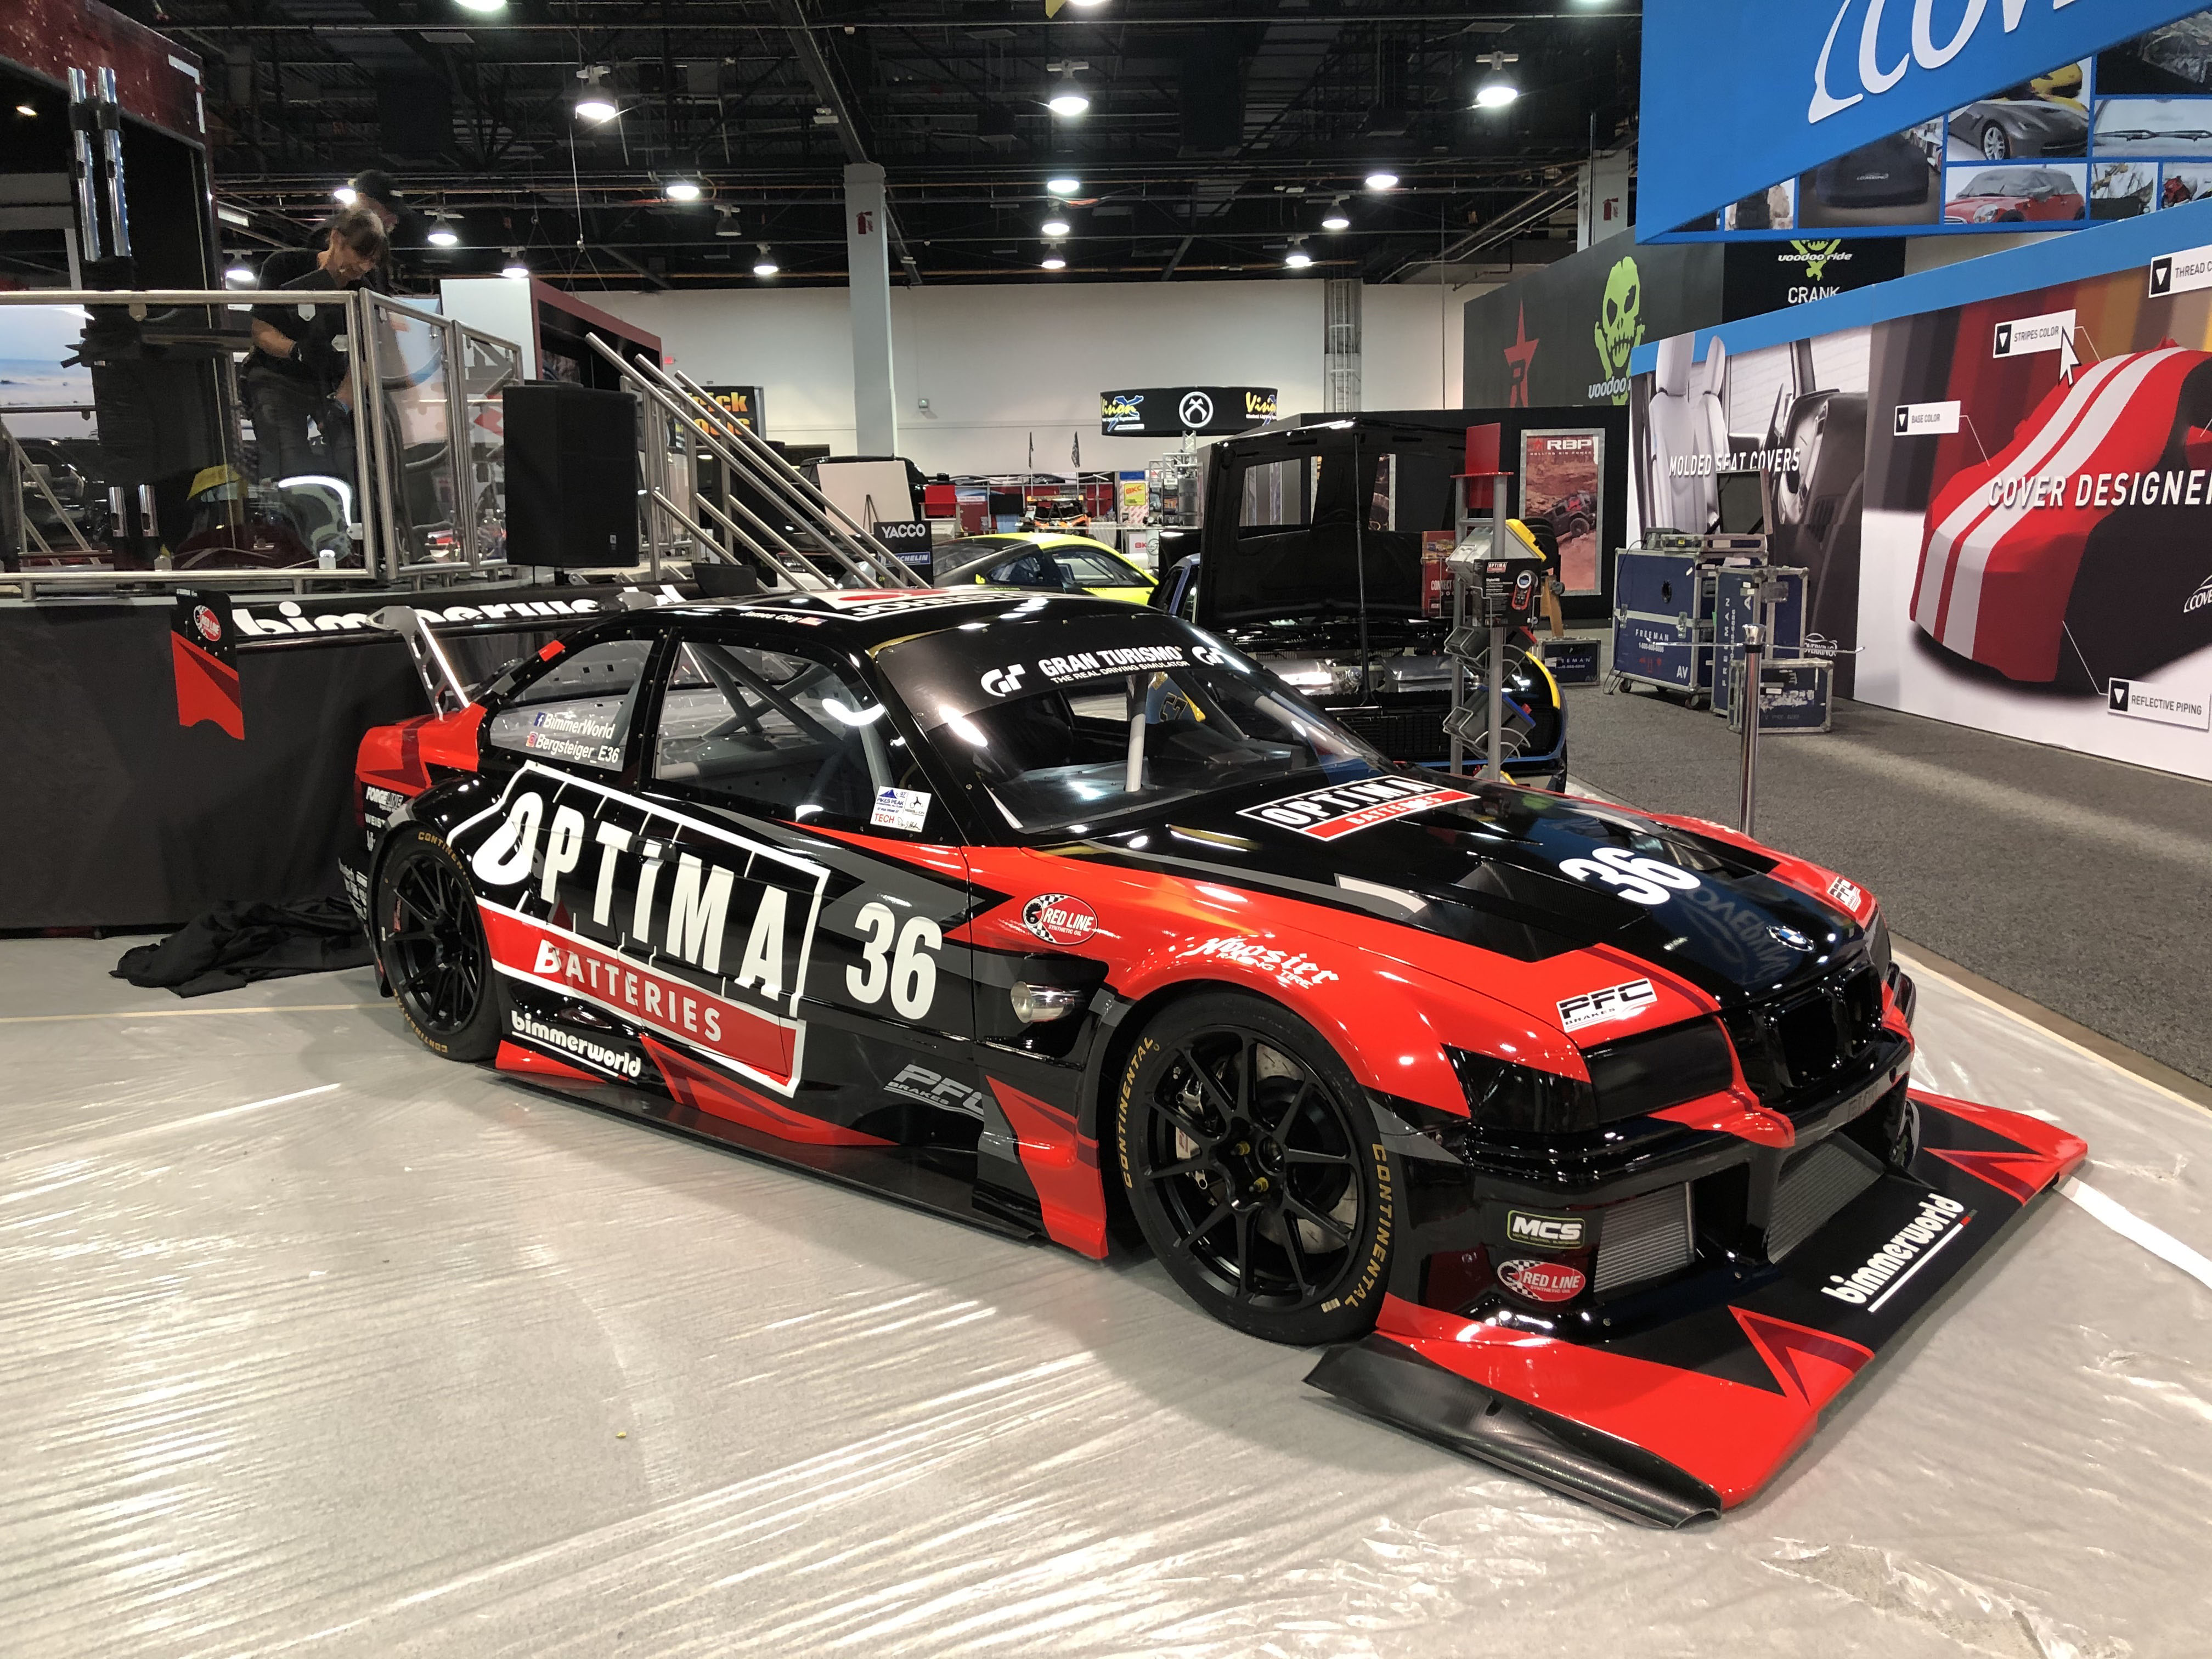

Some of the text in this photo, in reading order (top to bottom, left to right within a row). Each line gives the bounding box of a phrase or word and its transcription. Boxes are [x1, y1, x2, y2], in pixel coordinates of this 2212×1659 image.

[1778, 252, 1853, 262] voodoo ride
[2175, 263, 2206, 278] THREAD
[1787, 286, 1840, 304] CRANK
[2014, 326, 2059, 342] STRIPES COLOR
[1589, 376, 1627, 399] voodoo
[1245, 392, 1277, 413] Visio
[1911, 414, 1940, 424] BASE COLOR
[1547, 439, 1592, 450] RBP
[1669, 447, 1801, 476] MOLDED SEAT COVERS
[1988, 475, 2067, 507] COVER
[881, 523, 926, 538] YACCO
[775, 614, 803, 623] Clay
[1635, 629, 1669, 641] FREEMAN
[1722, 597, 1730, 686] FREEMAN
[1038, 646, 1183, 678] GRAN TURISMO
[1050, 661, 1190, 685] THE REAL DRIVING SIMULATOR
[1676, 665, 1688, 679] AV
[2131, 695, 2202, 715] REFLECTIVE PIPING
[543, 713, 616, 740] BimmerWorld
[535, 733, 620, 764] Bergsteiger_E36
[365, 786, 403, 808] FORGELINE
[1261, 779, 1437, 825] OPTIMA
[874, 813, 895, 823] TECH
[1558, 847, 1701, 905] 36
[472, 792, 788, 1002] OPTIMA
[1042, 907, 1094, 932] RED LINE
[1048, 924, 1074, 935] SYNTHETIC
[845, 901, 944, 1020] 36
[533, 939, 723, 1043] BATTERIES
[1280, 969, 1314, 990] TIRE
[1559, 980, 1654, 1020] PFC
[510, 1009, 643, 1078] bimmerworld
[887, 1081, 950, 1105] BRAKES
[1118, 1037, 1154, 1189] CONTINENTAL
[1344, 1143, 1393, 1307] CONTINENTAL
[1512, 1216, 1582, 1240] MCS
[1820, 1192, 1965, 1304] bimmerworld
[1522, 1271, 1581, 1289] RED LINE
[1530, 1285, 1561, 1294] SYNTHETIC
